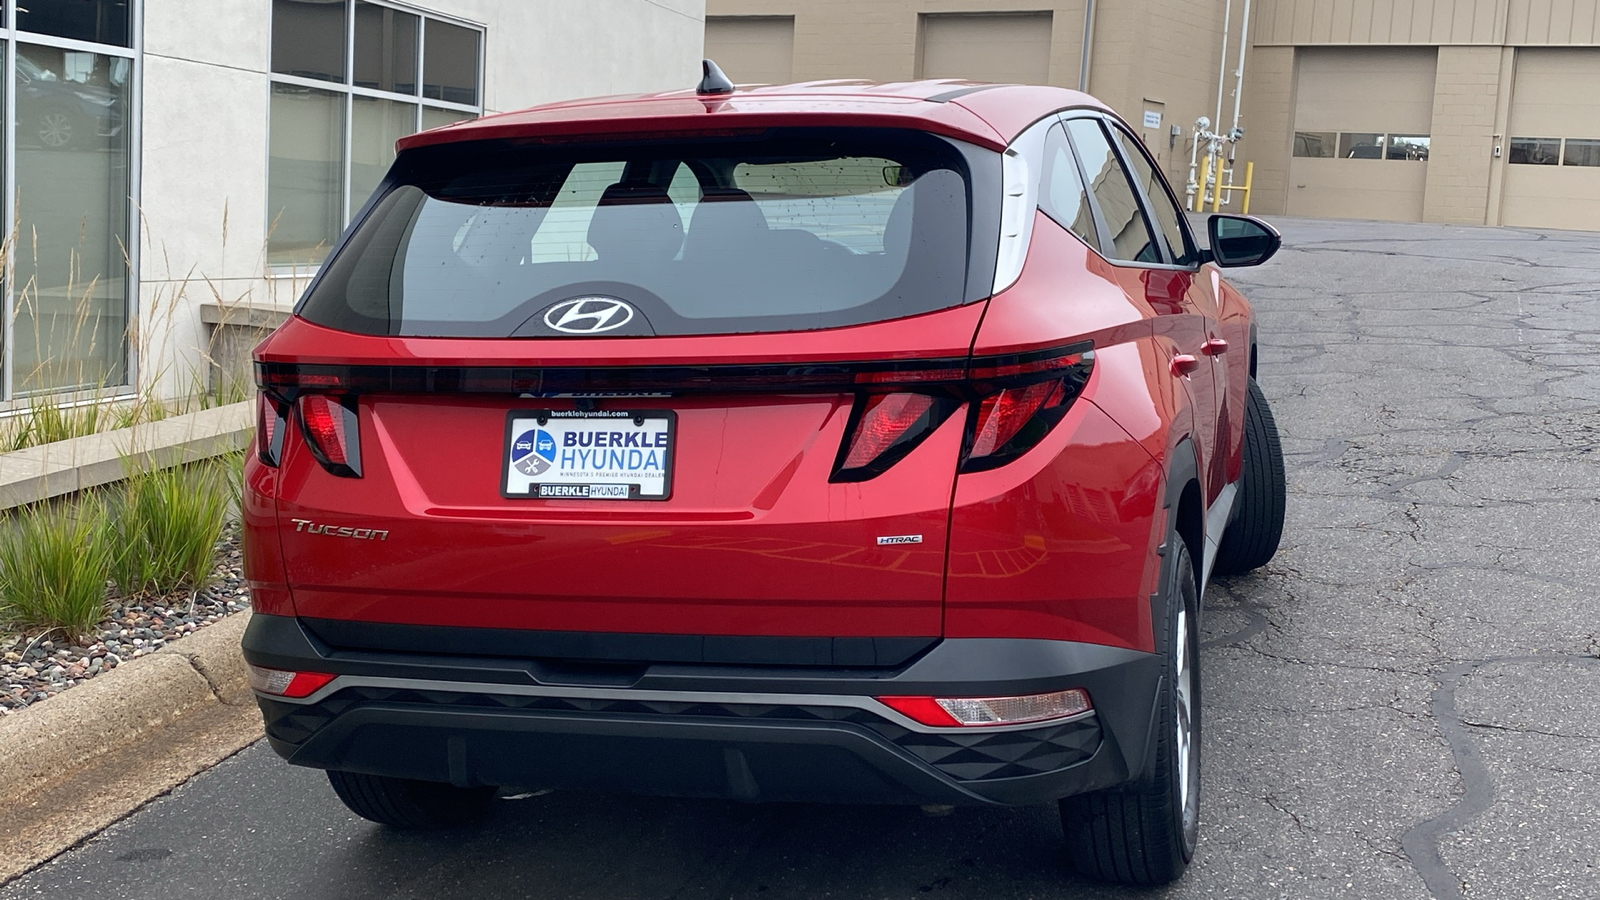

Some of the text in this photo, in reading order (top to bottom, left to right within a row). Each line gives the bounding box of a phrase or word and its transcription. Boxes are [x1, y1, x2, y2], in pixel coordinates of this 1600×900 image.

[551, 410, 628, 418] buerklehyundai.com
[564, 432, 667, 448] BUERKLE
[540, 486, 627, 496] BUERKLE HYUNDAI
